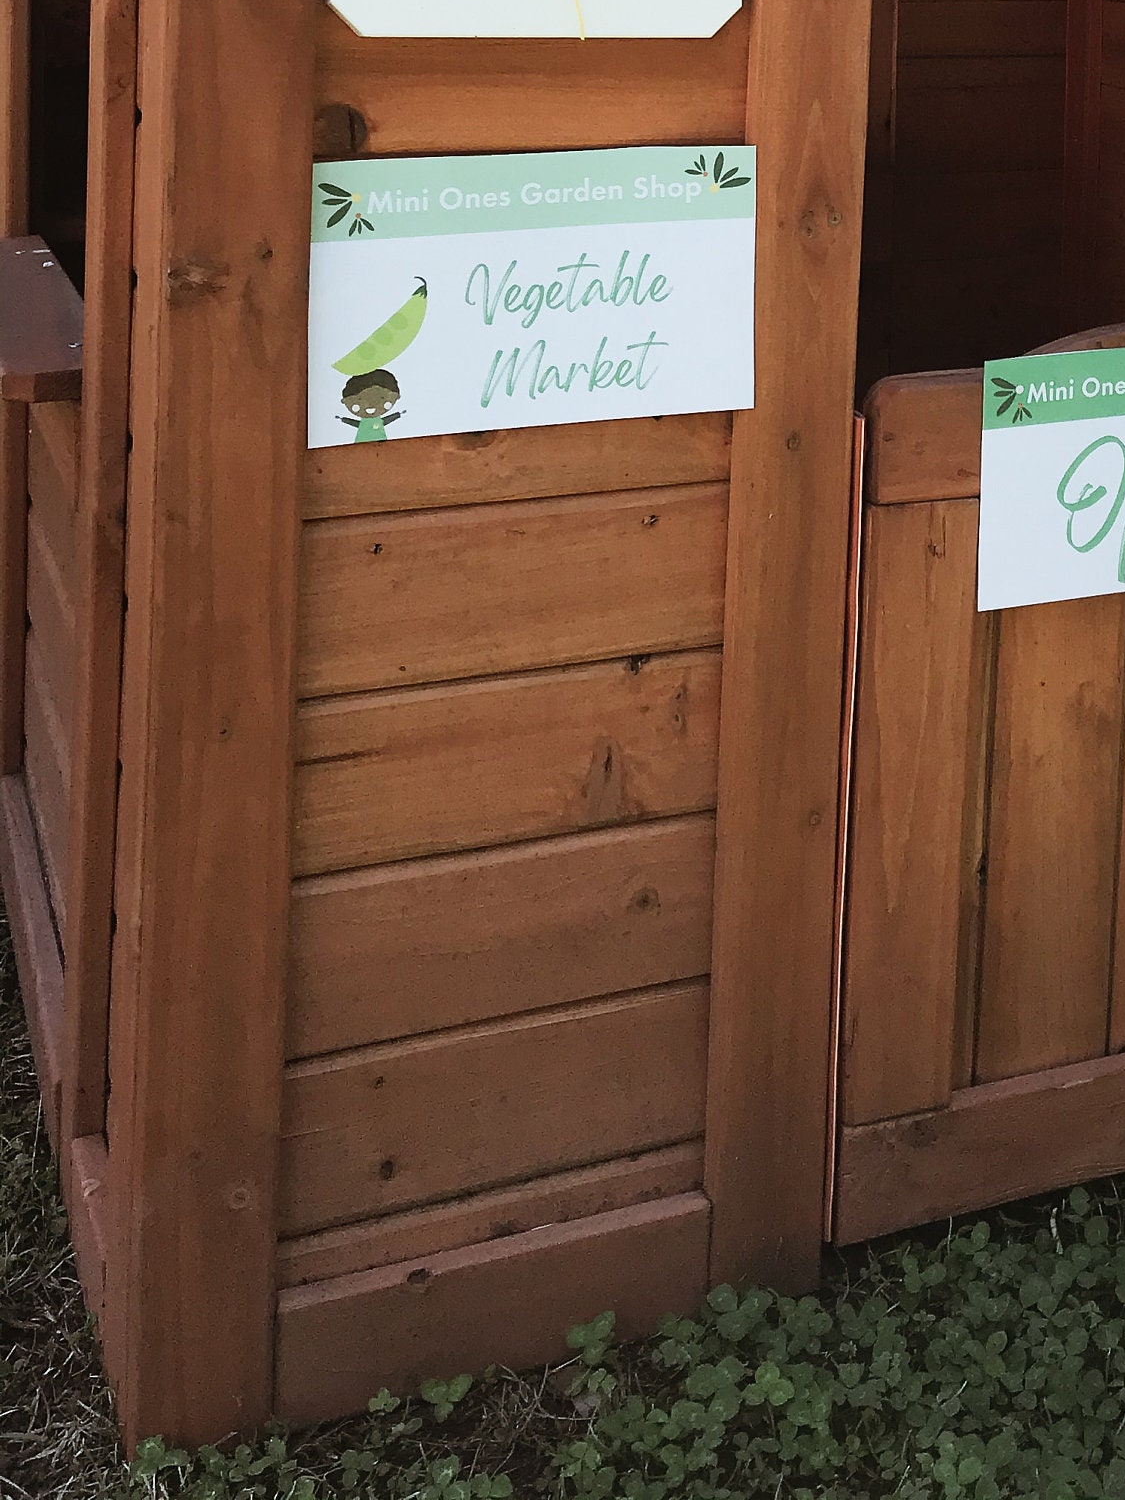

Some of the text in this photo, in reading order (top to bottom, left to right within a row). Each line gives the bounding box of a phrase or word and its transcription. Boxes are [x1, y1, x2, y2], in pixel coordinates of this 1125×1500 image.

[366, 174, 702, 215] Mini Ones Garden Shop
[465, 250, 674, 329] Vegetable
[480, 331, 669, 409] Market
[1026, 379, 1074, 404] Mini
